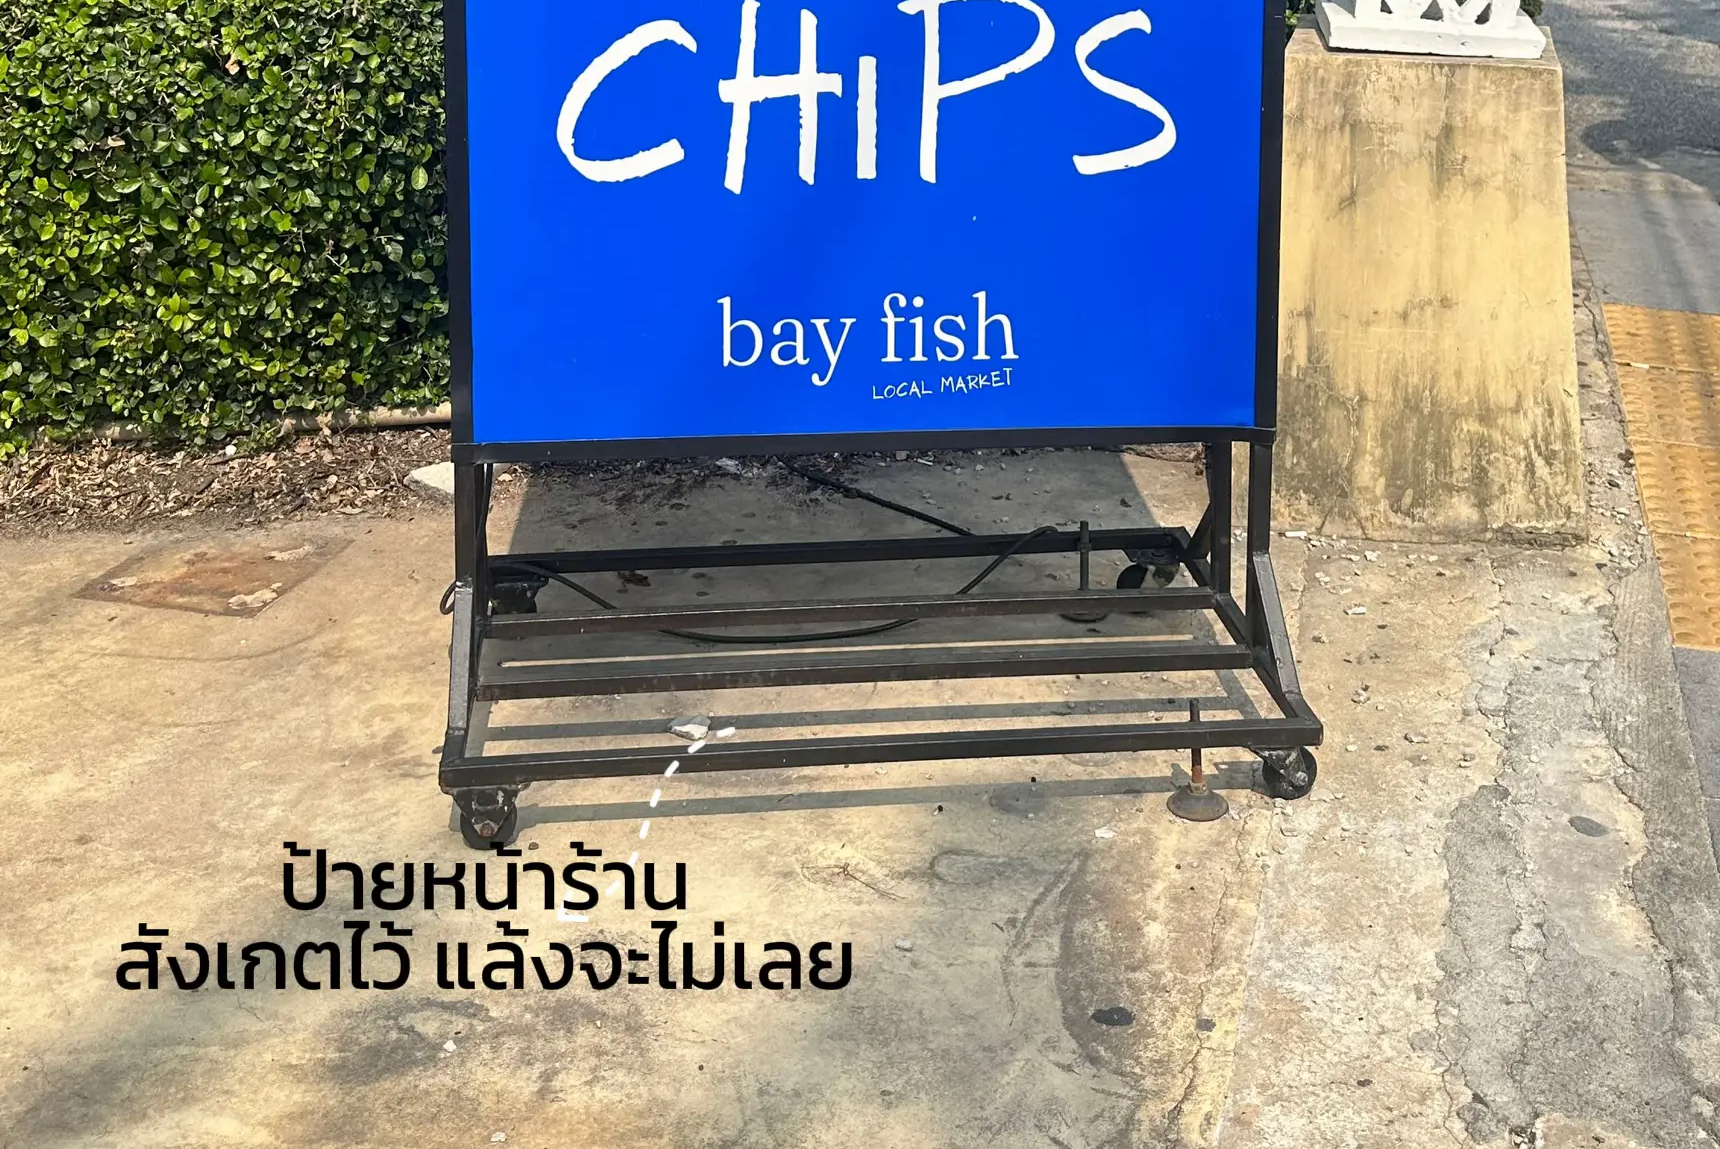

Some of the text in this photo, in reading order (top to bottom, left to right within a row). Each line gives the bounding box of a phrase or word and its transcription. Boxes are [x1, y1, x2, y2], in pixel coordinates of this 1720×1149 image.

[717, 290, 1019, 387] bay fish
[872, 367, 1013, 400] LOCAL MARKET
